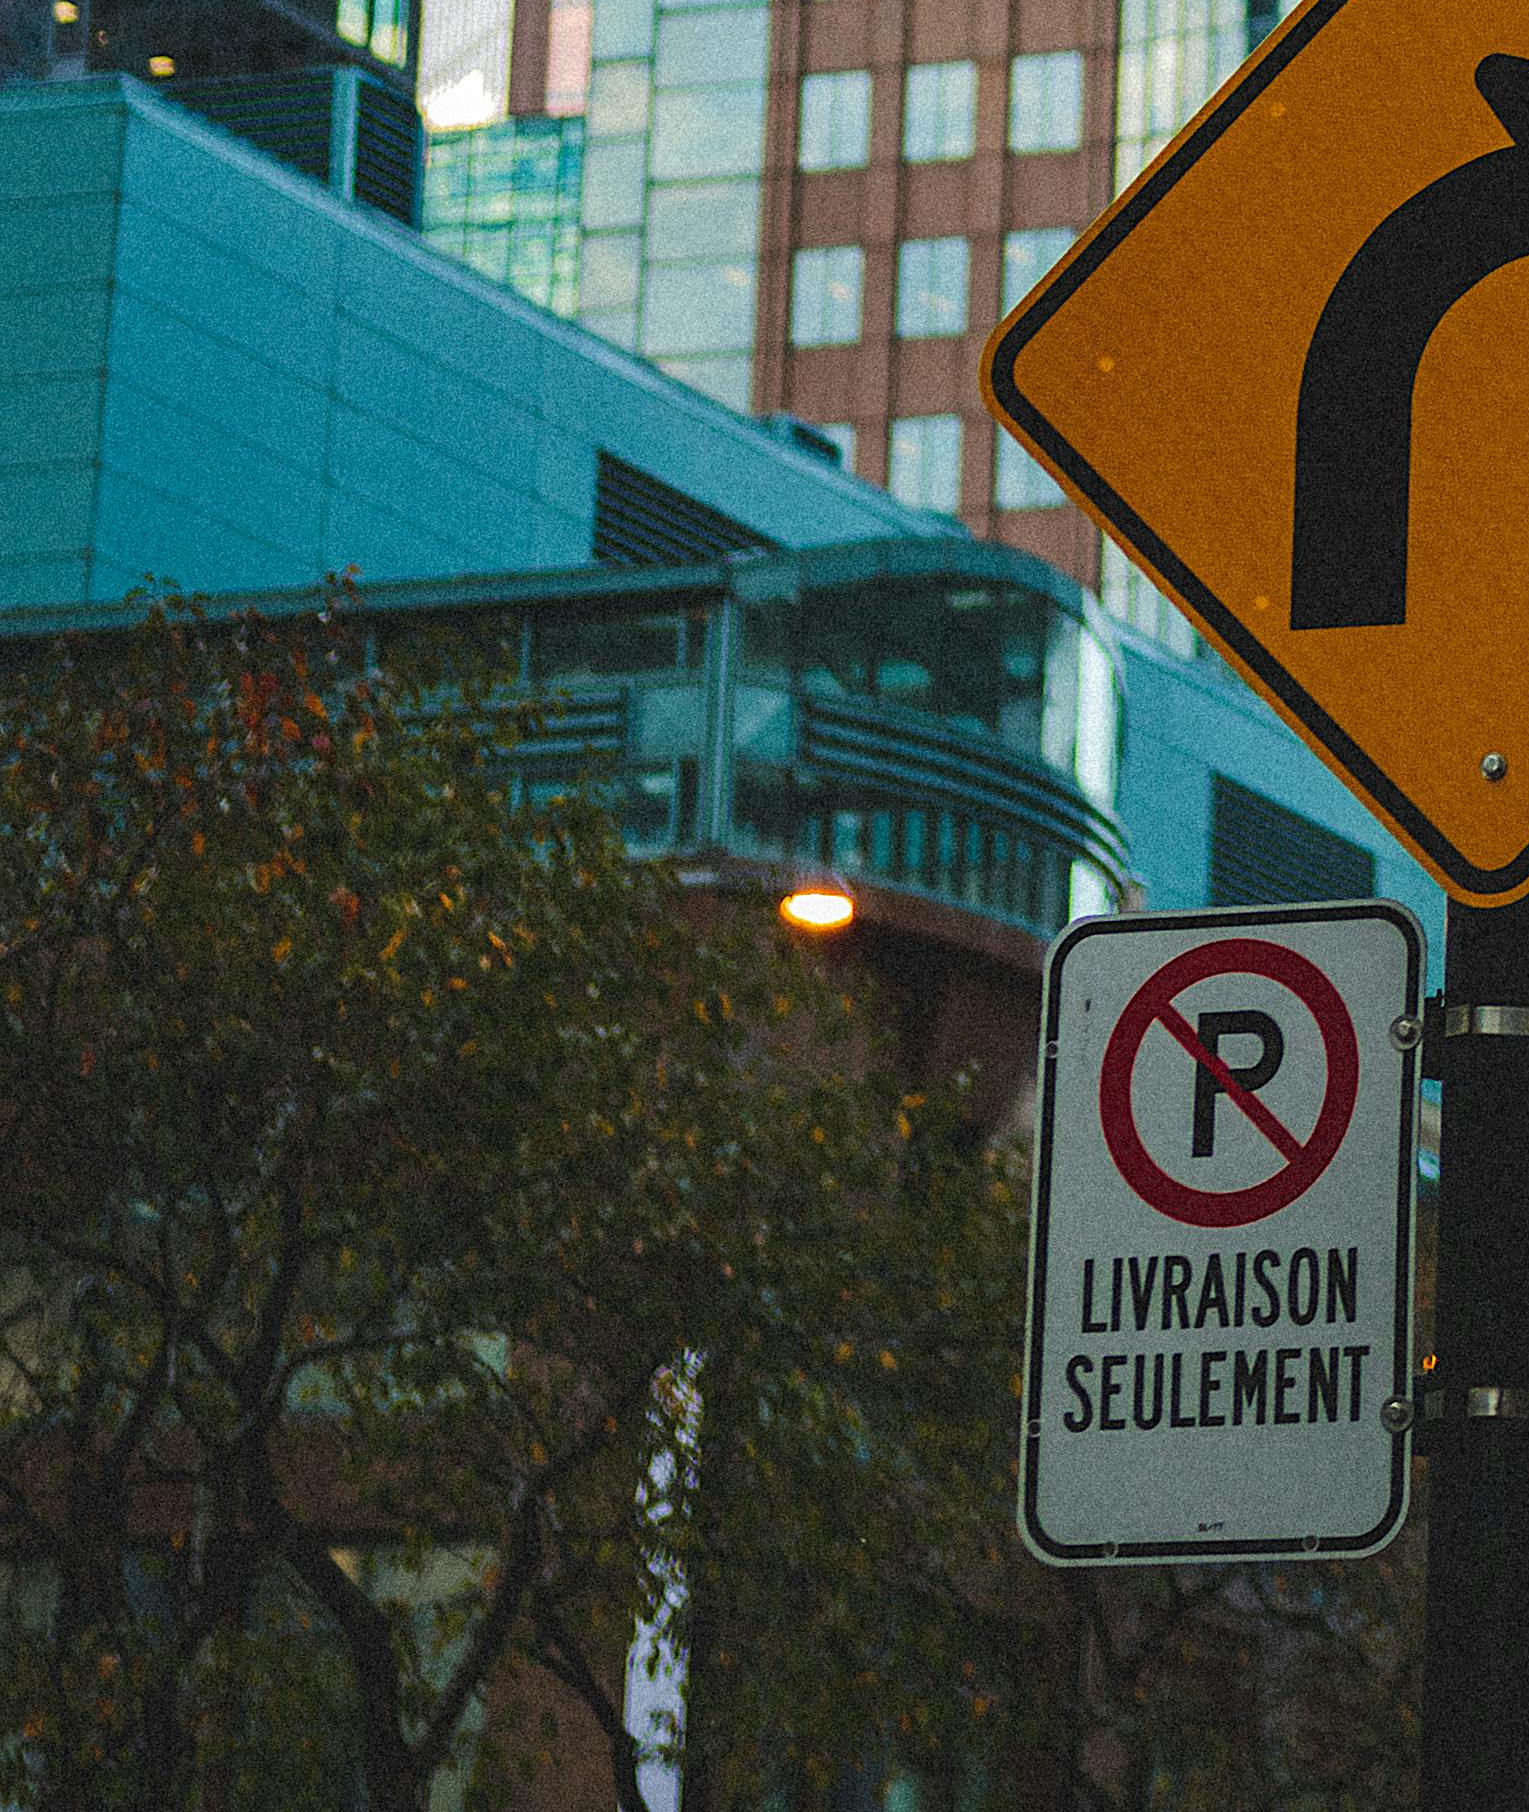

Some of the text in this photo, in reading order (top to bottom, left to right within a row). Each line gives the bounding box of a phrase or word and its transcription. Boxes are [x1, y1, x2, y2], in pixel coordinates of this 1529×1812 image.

[1192, 1009, 1285, 1158] P
[1080, 1246, 1358, 1334] LIVRAISON
[1062, 1345, 1371, 1433] SEULEMENT
